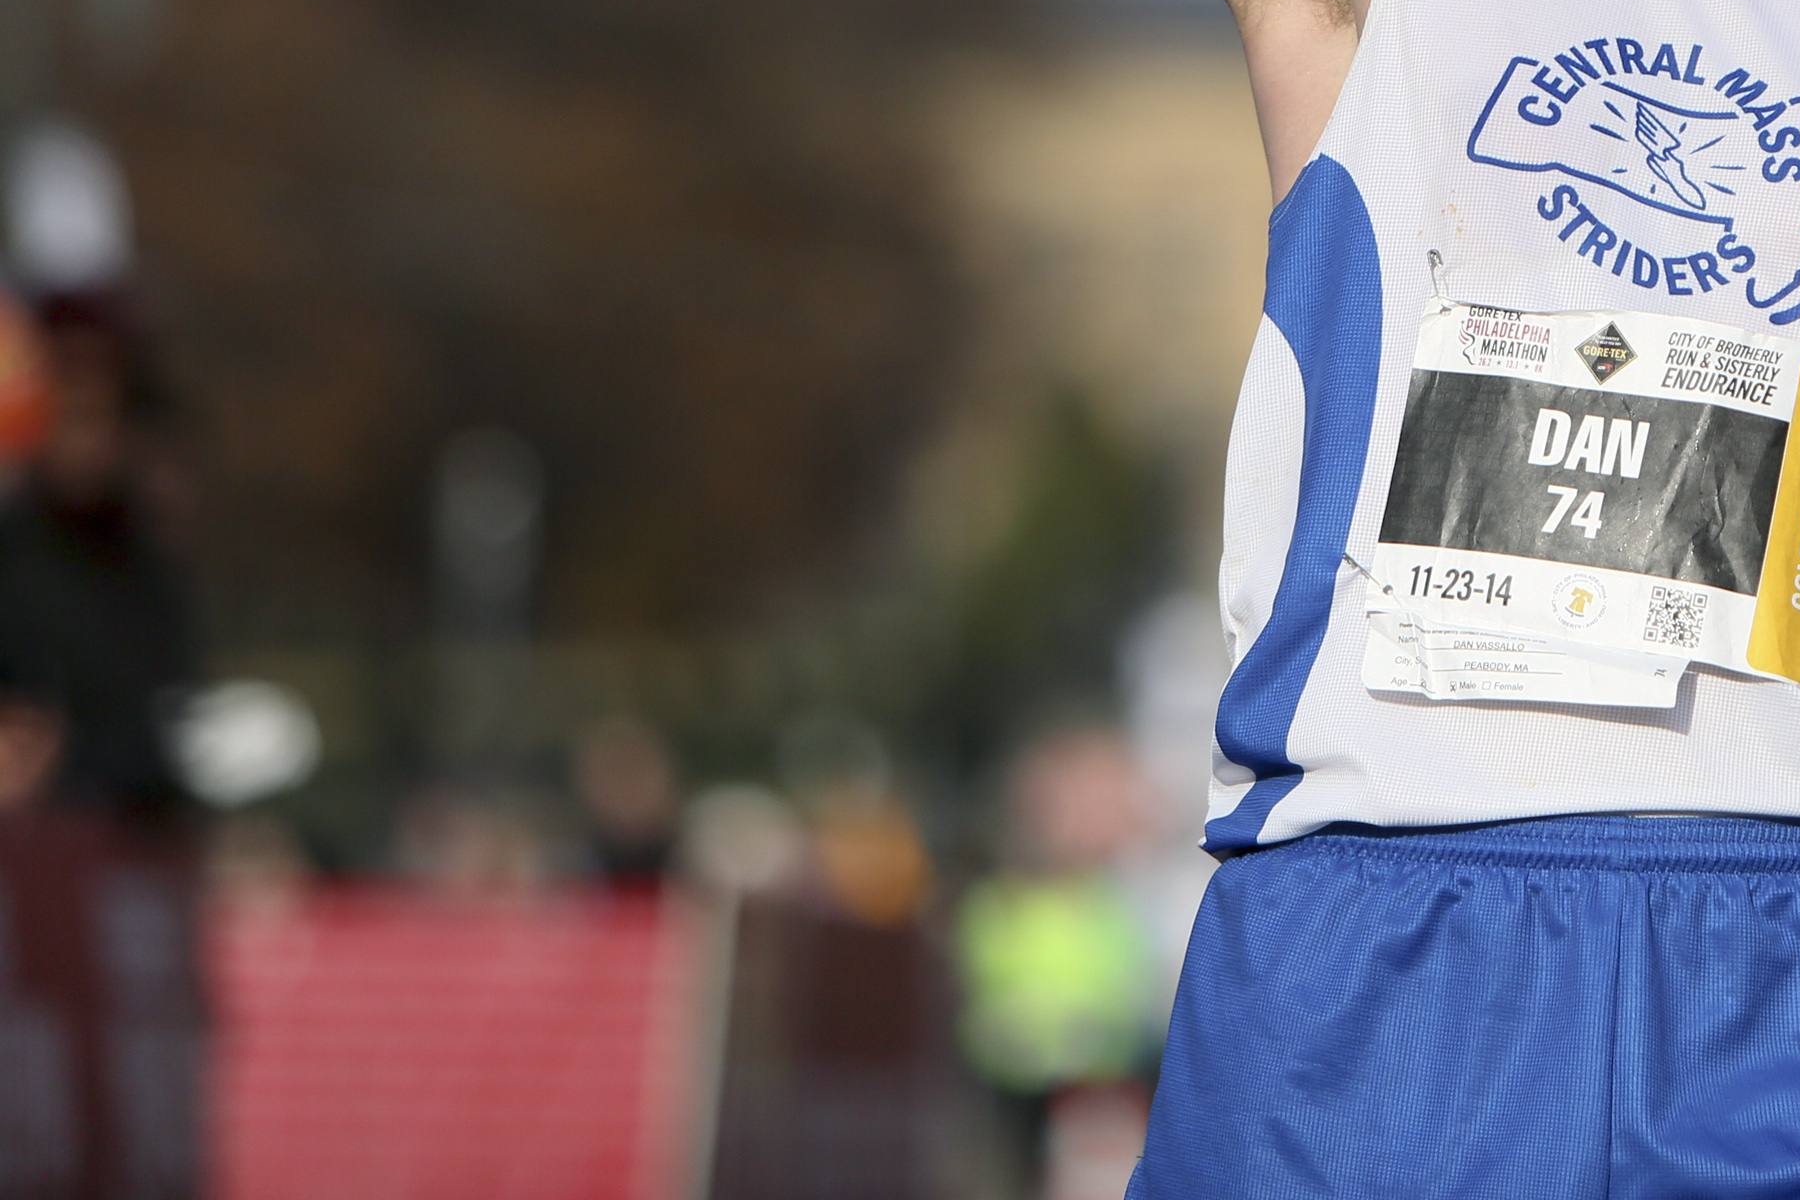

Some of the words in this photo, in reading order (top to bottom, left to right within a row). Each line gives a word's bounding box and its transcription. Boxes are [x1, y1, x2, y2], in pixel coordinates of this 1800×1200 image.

[1517, 36, 1705, 128] CENTRAL
[1536, 184, 1756, 296] STRIDERS
[1465, 318, 1550, 344] PHILADELPHIA
[1478, 357, 1492, 367] 26.2
[1506, 359, 1519, 369] 13.1
[1480, 338, 1548, 363] MARATHON
[1668, 332, 1697, 348] CITY
[1696, 335, 1715, 349] OF
[1715, 339, 1784, 364] BROTHERLY
[1665, 348, 1698, 367] RUN
[1699, 351, 1711, 369] &
[1714, 356, 1781, 383] SISTERLY
[1660, 367, 1778, 406] ENDURANCE
[1527, 408, 1650, 479] DAN
[1540, 485, 1606, 540] 74
[1409, 566, 1513, 607] 11-23-14
[1453, 640, 1474, 650] DAN
[1475, 641, 1525, 652] VASSALLO
[1464, 661, 1512, 673] PEABODY,
[1514, 663, 1529, 673] MA
[1459, 681, 1476, 690] Male
[1494, 682, 1524, 692] Female
